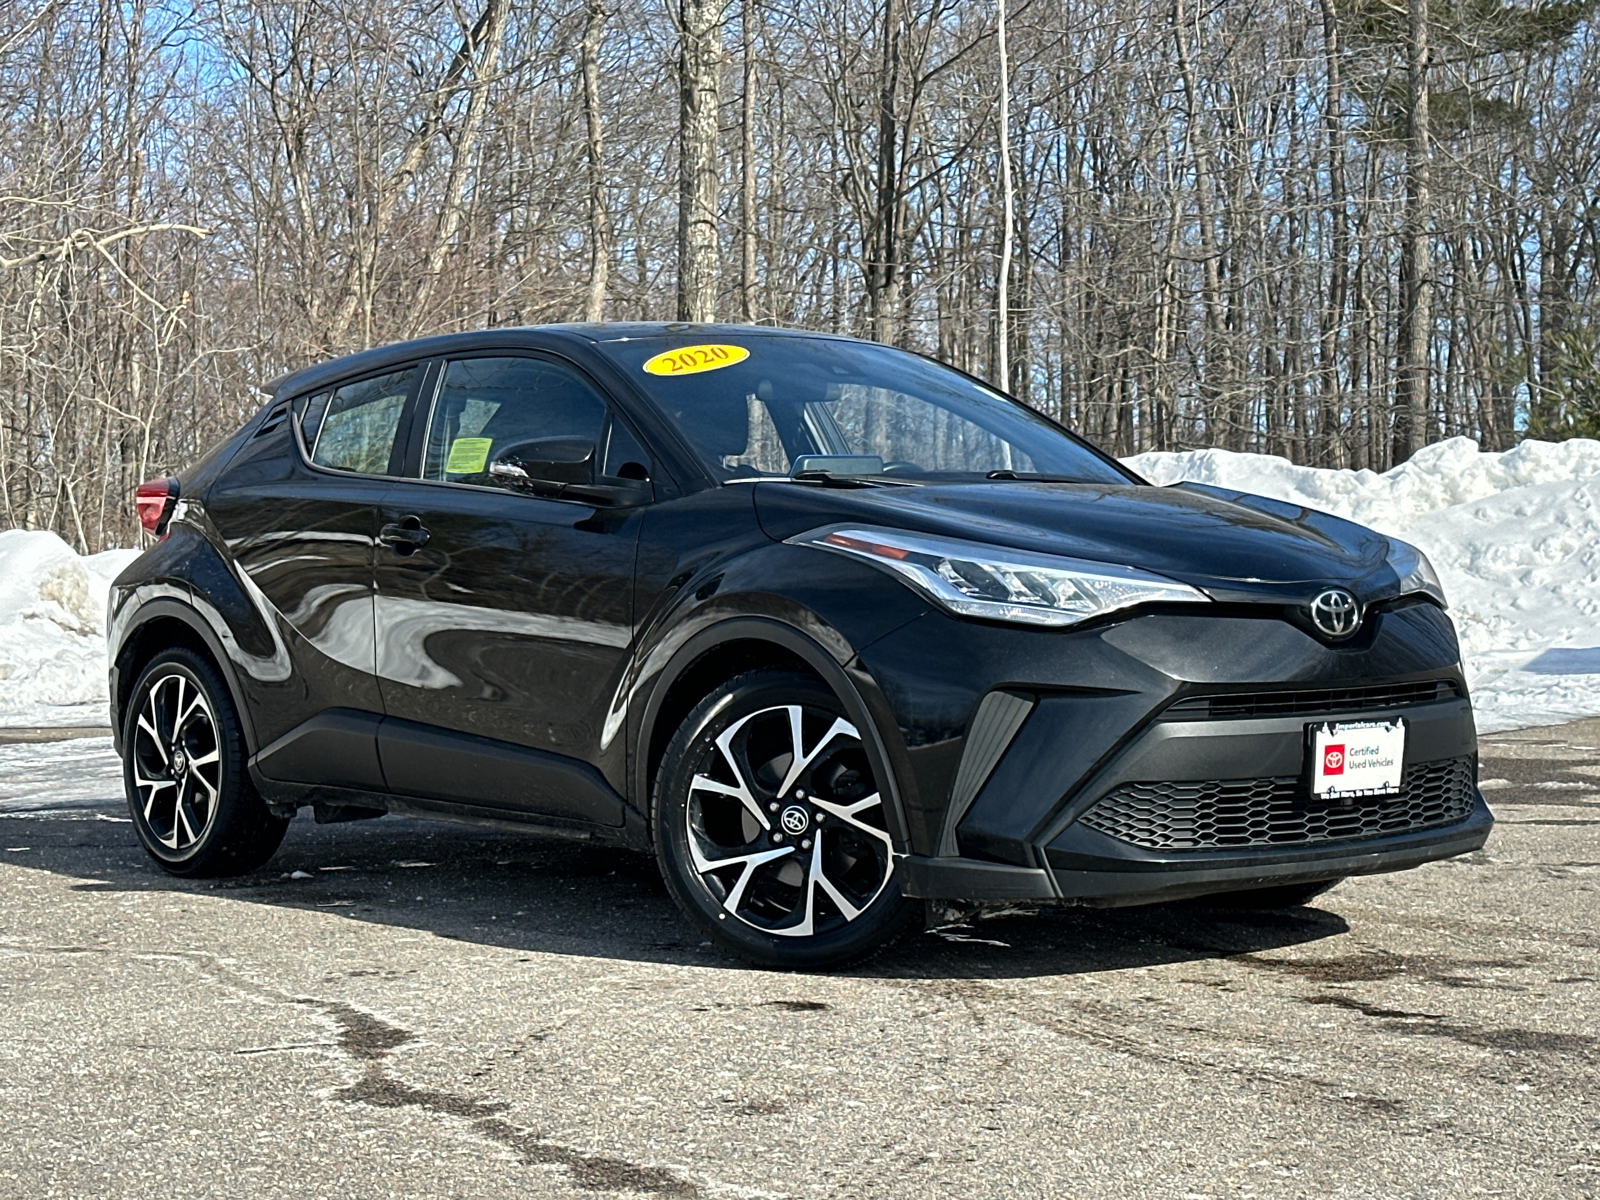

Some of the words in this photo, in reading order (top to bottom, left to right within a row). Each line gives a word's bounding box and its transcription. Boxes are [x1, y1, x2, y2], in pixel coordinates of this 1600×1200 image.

[662, 347, 729, 372] 2020
[1349, 746, 1379, 757] Certified
[1349, 760, 1366, 769] Used
[1368, 758, 1394, 767] Vehicles
